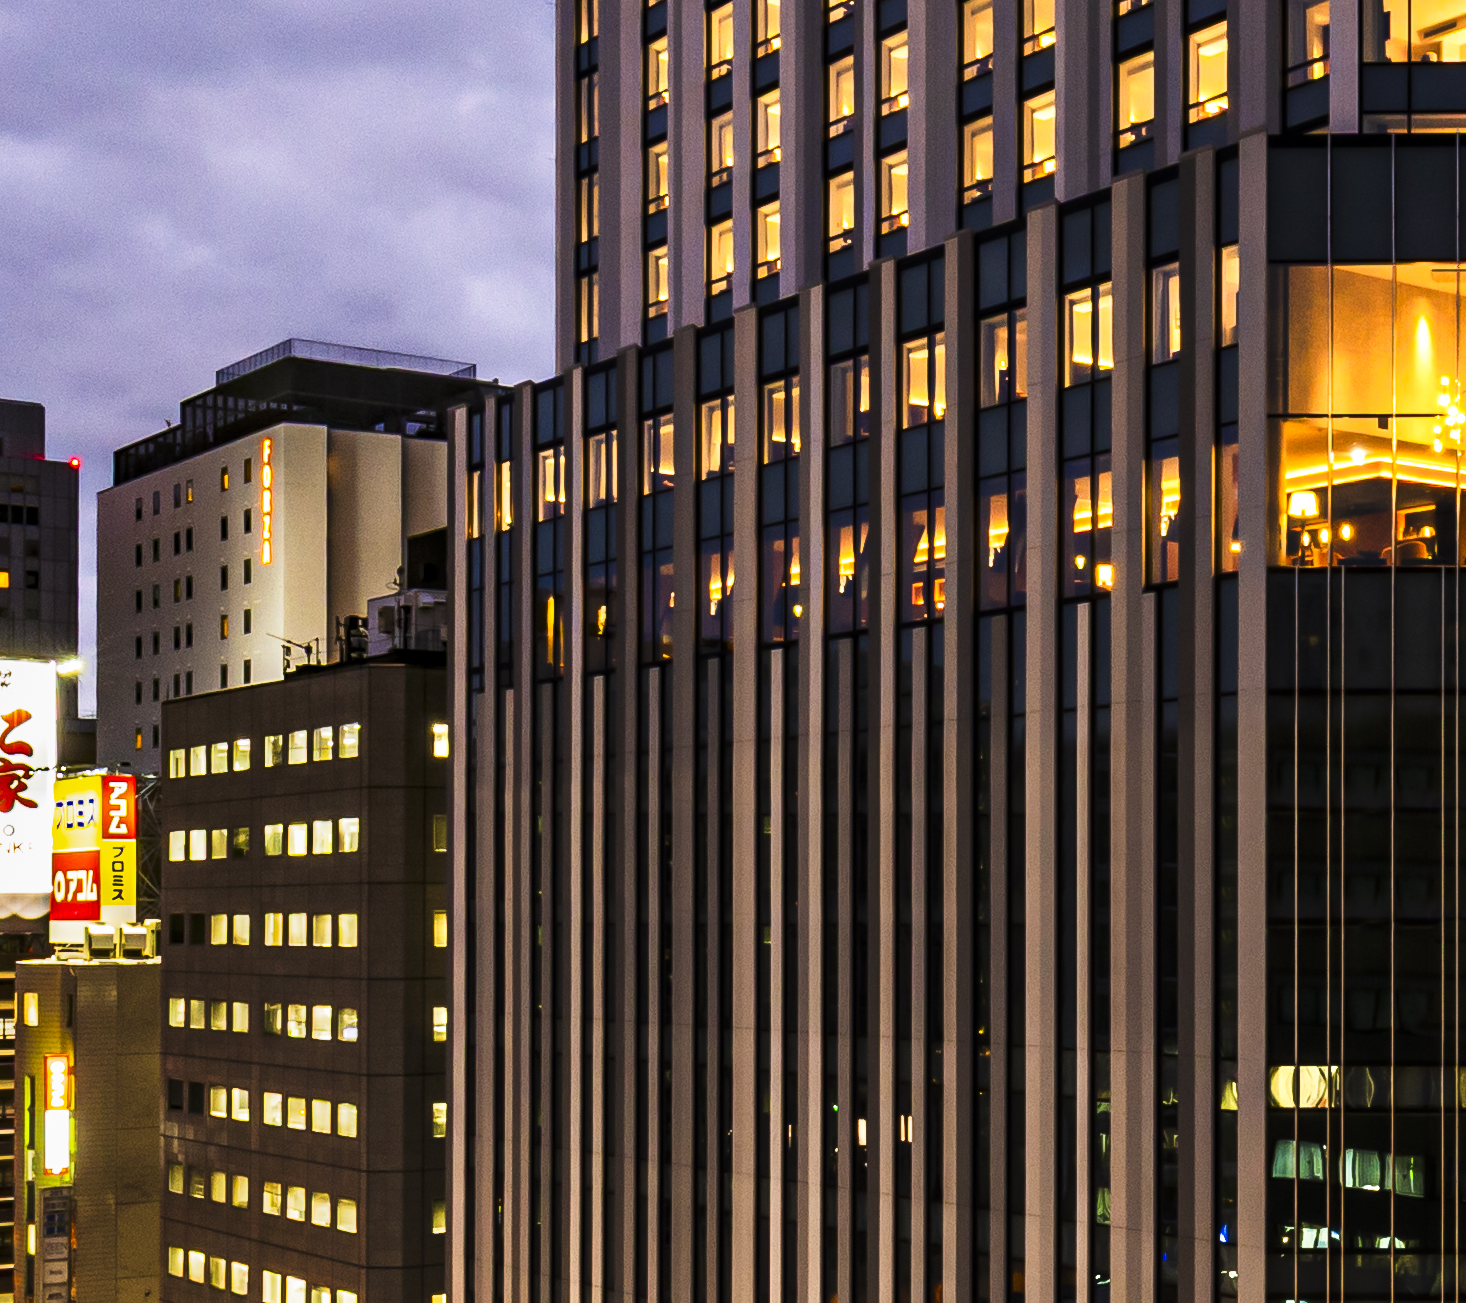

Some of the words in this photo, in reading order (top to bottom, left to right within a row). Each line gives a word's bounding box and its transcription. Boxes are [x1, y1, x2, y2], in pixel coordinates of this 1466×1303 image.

[108, 781, 129, 835] アコム
[111, 846, 126, 901] プロミス
